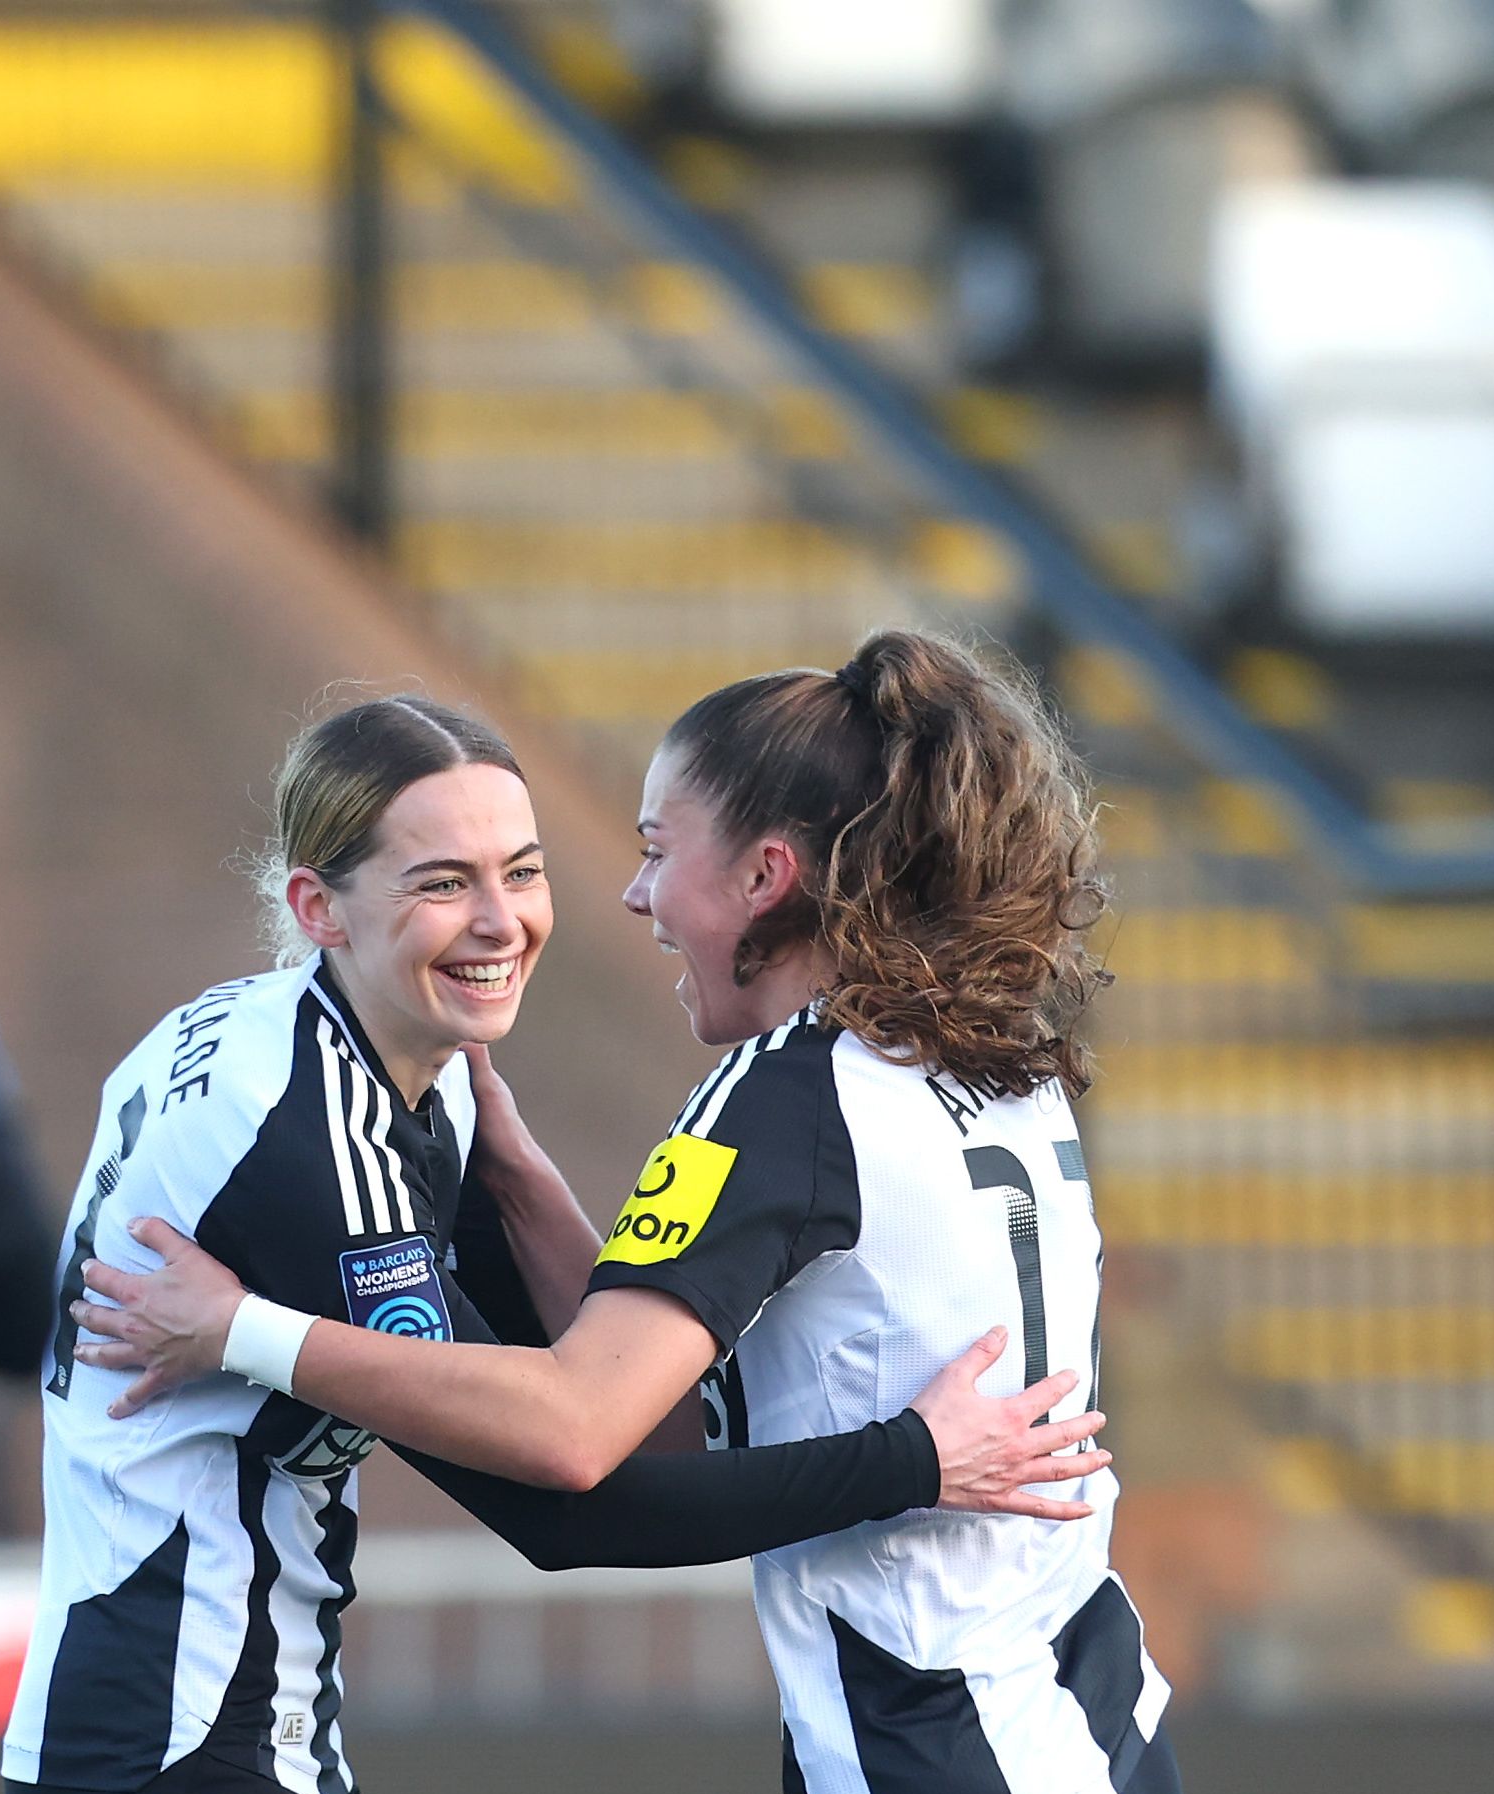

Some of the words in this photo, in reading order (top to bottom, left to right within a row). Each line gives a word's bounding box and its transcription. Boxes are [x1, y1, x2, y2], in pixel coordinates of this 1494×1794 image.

[605, 1213, 690, 1244] oon
[368, 1247, 426, 1271] BARCLAYS
[353, 1260, 427, 1288] WOMEN'S
[356, 1272, 430, 1297] CHAMPIONSHIP
